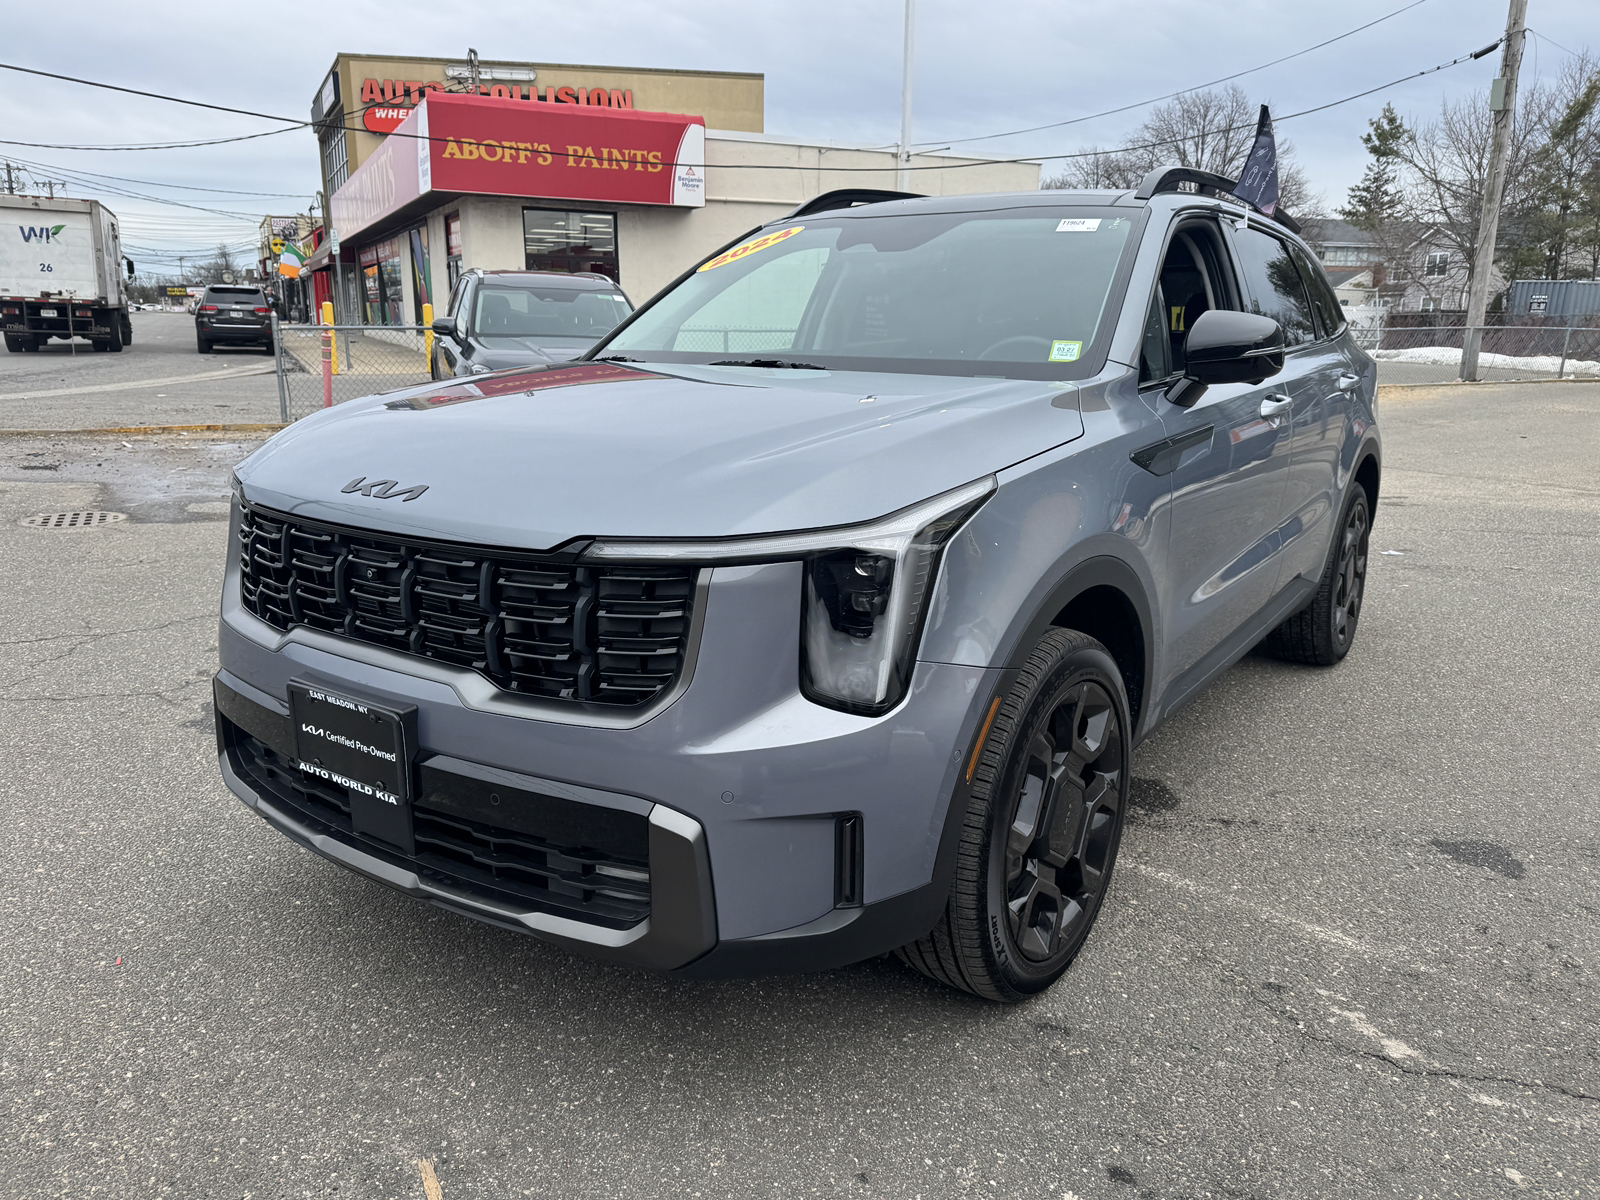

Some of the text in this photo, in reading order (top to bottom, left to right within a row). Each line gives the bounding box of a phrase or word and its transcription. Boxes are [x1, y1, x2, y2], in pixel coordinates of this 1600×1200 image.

[442, 136, 552, 166] ABOFF'S
[566, 145, 662, 172] PAINTS
[678, 175, 703, 183] Benjamin
[707, 229, 792, 269] 2024
[40, 263, 53, 272] 26
[340, 476, 430, 503] KIA
[309, 690, 326, 702] EAST
[357, 704, 368, 714] NY
[302, 723, 396, 762] KIA Certified Pre-Owned
[299, 762, 398, 806] AUTO WORLD KIA
